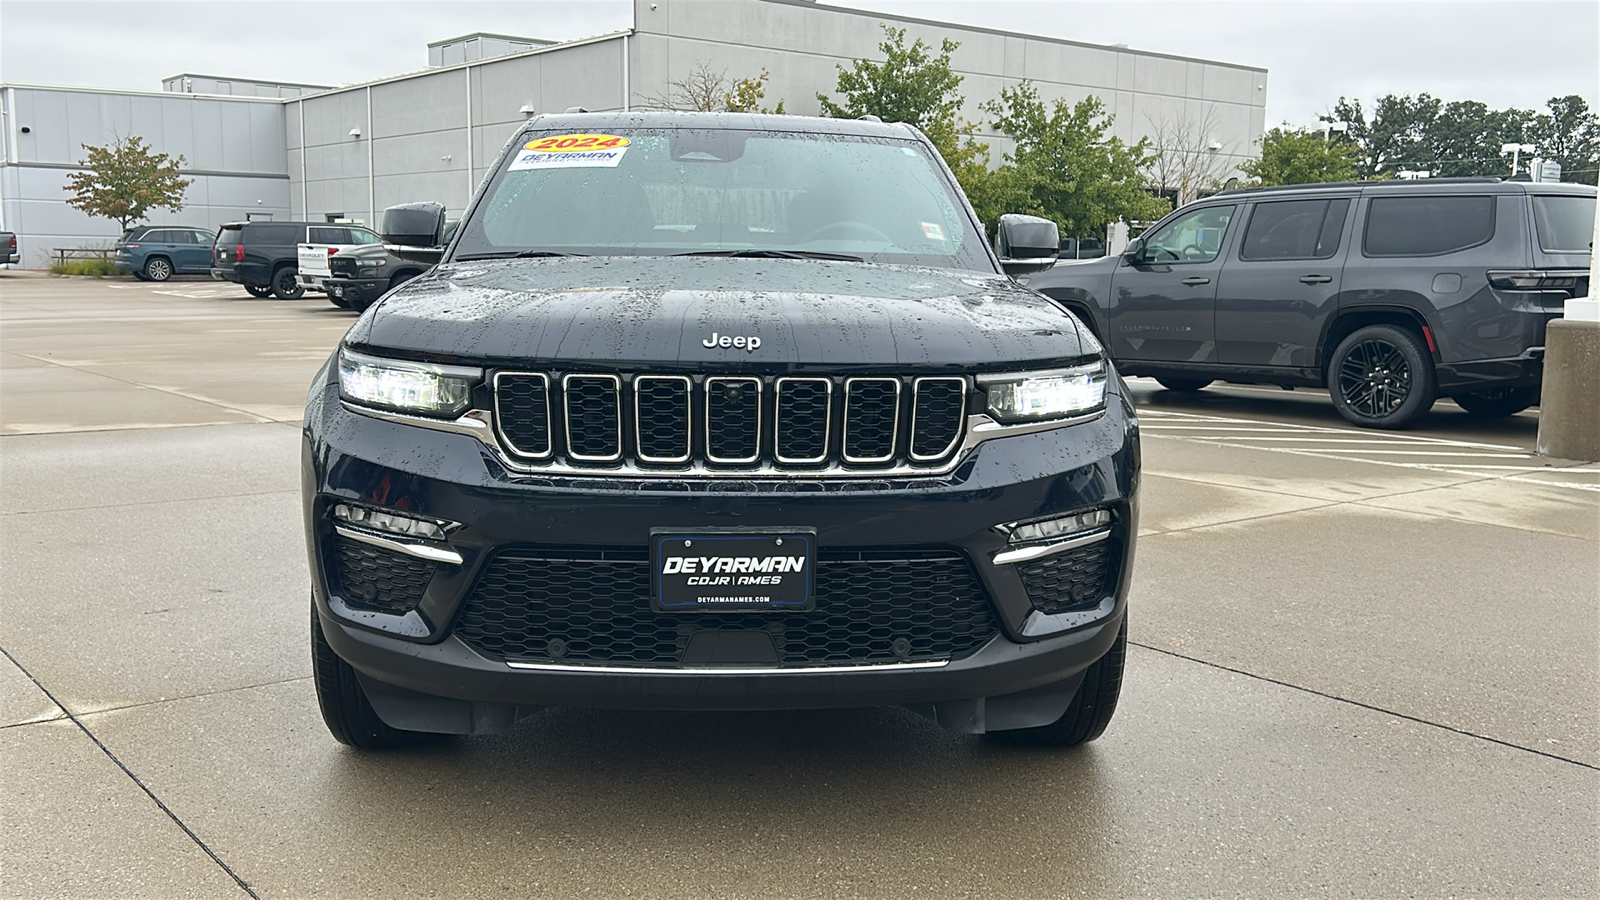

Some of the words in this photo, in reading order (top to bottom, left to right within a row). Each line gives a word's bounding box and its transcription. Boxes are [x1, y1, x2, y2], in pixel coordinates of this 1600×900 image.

[532, 138, 621, 149] 2024
[521, 153, 618, 161] DEYARMAN
[702, 332, 761, 350] Jeep
[663, 556, 805, 574] DEYARMAN
[687, 576, 730, 585] CDJR
[737, 576, 782, 585] AMES
